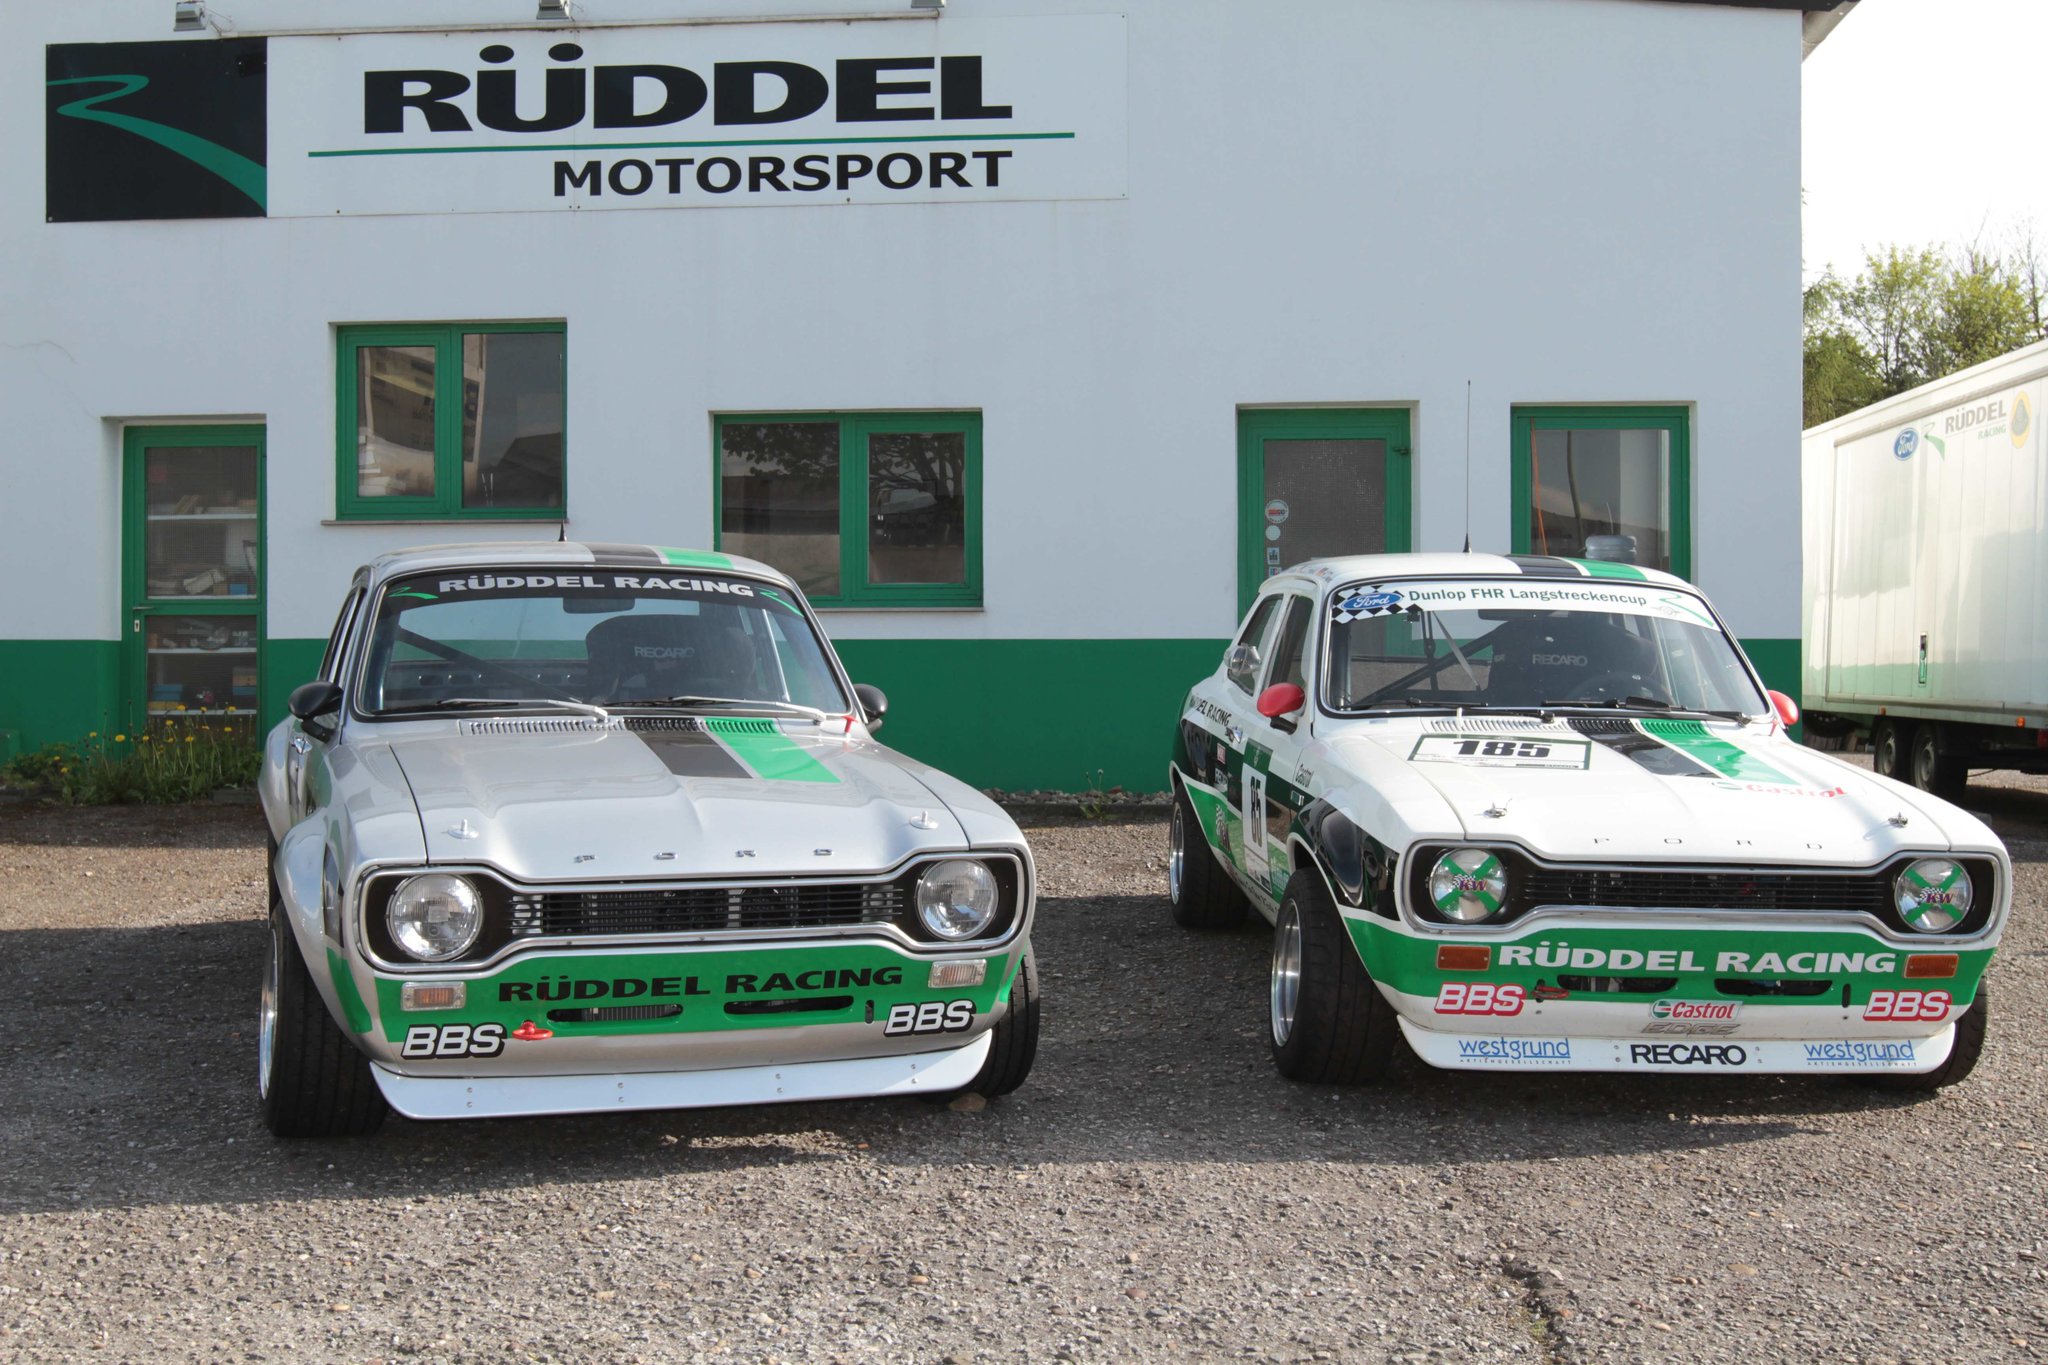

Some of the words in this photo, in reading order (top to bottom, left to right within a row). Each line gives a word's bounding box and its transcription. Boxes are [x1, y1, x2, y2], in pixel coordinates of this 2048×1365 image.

[364, 42, 1013, 133] RÜDDEL
[554, 151, 1012, 195] MOTORSPORT
[1945, 400, 2007, 434] RÜDDEL
[439, 574, 605, 592] RÜDDEL
[614, 577, 754, 596] RACING
[1354, 593, 1390, 608] Ford
[1409, 590, 1466, 603] Dunlop
[1471, 588, 1505, 600] FHR
[1510, 590, 1647, 606] Langstreckencup
[634, 646, 695, 658] RECARO
[1532, 654, 1588, 666] RECARO
[1206, 704, 1232, 727] RACING
[1453, 740, 1552, 758] 185
[575, 848, 832, 862] FORD
[1458, 879, 1488, 891] KW
[1926, 893, 1954, 904] KW
[1498, 941, 1706, 972] RÜDDEL
[1715, 952, 1897, 974] RACING
[499, 976, 709, 1002] RÜDDEL
[725, 967, 902, 993] RACING
[1437, 984, 1523, 1012] BBS
[1866, 992, 1951, 1020] BBS
[885, 1001, 974, 1036] BBS
[1672, 1001, 1736, 1019] Castrol
[403, 1026, 504, 1056] BBS
[1459, 1037, 1571, 1060] westgrund
[1804, 1040, 1915, 1062] westgrund
[1630, 1044, 1747, 1066] RECARO
